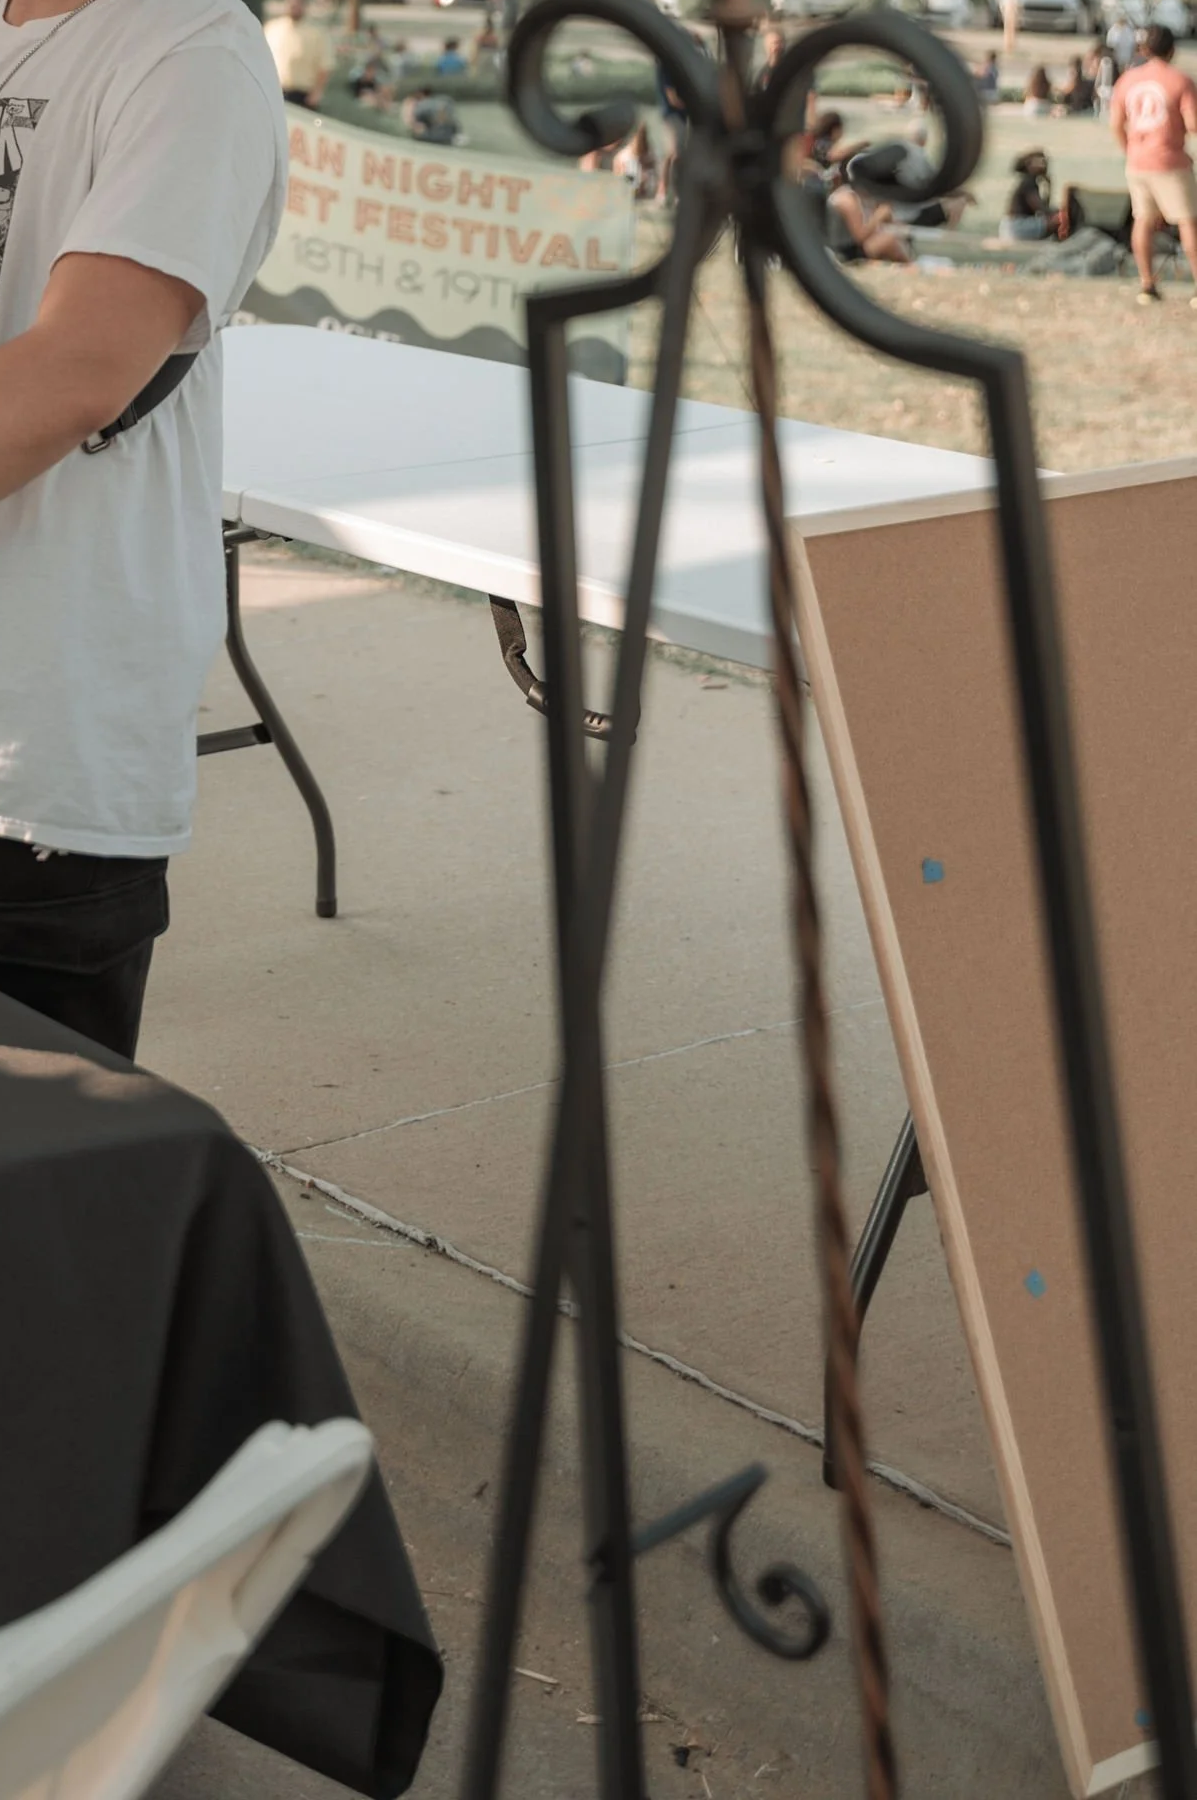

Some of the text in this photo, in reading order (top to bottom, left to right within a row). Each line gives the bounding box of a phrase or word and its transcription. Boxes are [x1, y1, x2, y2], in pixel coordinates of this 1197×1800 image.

[362, 151, 533, 213] NIGHT
[353, 197, 618, 271] FESTIVAL
[395, 259, 425, 295] &
